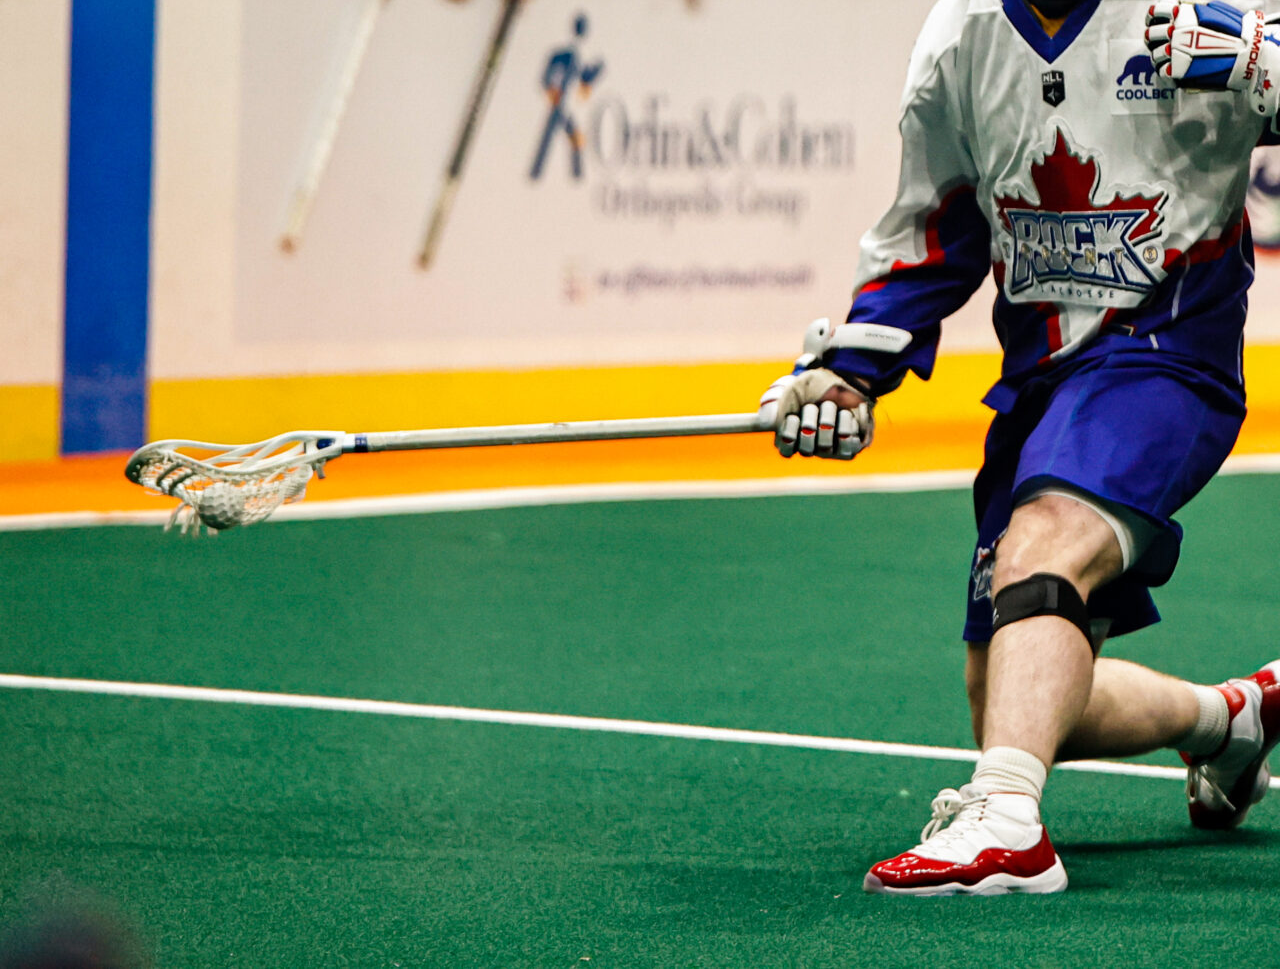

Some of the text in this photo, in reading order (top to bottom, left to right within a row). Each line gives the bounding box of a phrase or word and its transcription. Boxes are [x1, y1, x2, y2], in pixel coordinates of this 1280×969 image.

[1243, 22, 1264, 81] ARMOUR
[1042, 72, 1062, 83] NLL
[1116, 88, 1175, 100] COOLBET
[1006, 209, 1156, 293] ROCK
[1039, 283, 1115, 299] LACROSSE
